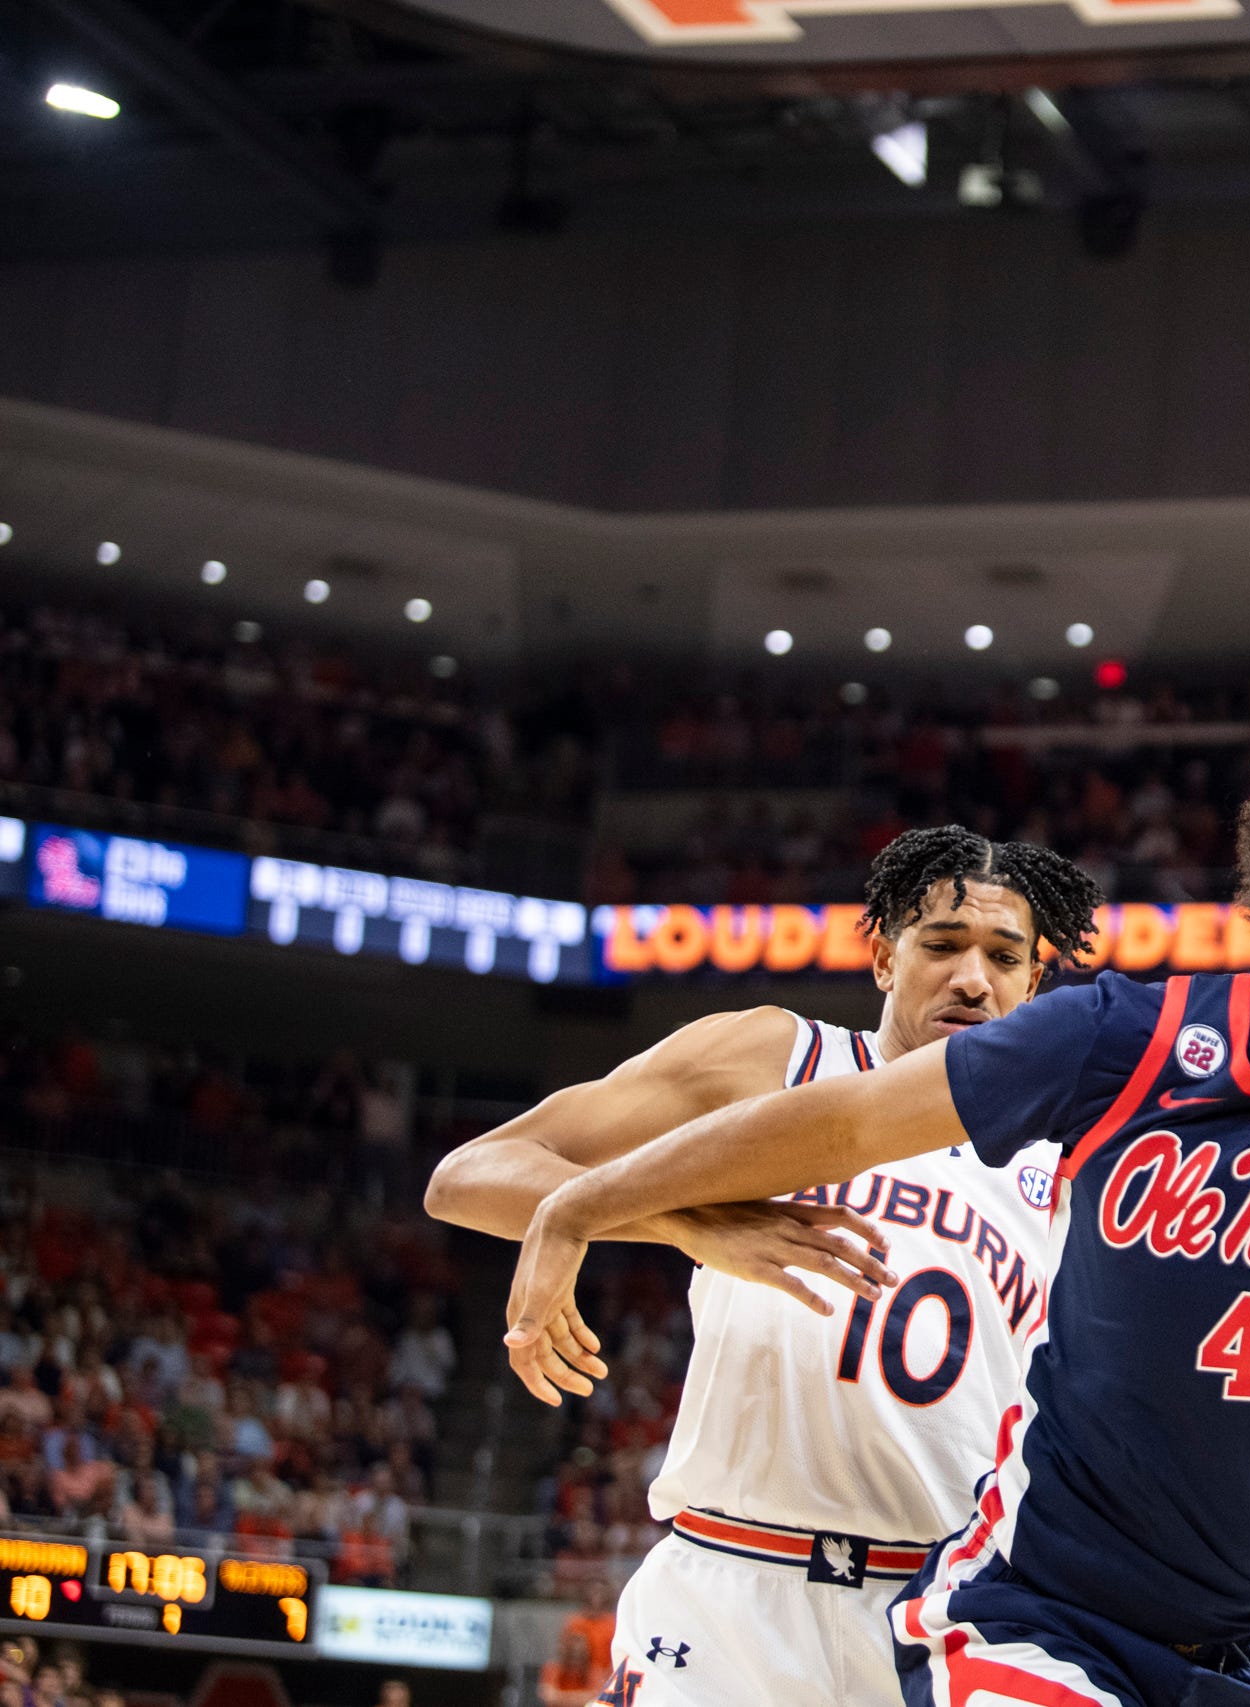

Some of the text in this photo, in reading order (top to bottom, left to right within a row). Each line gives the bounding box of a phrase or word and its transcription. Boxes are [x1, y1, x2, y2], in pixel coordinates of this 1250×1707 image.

[602, 903, 874, 973] LOUDE
[1183, 1040, 1216, 1072] 22
[1101, 1131, 1226, 1259] Ole
[836, 1241, 974, 1408] 10
